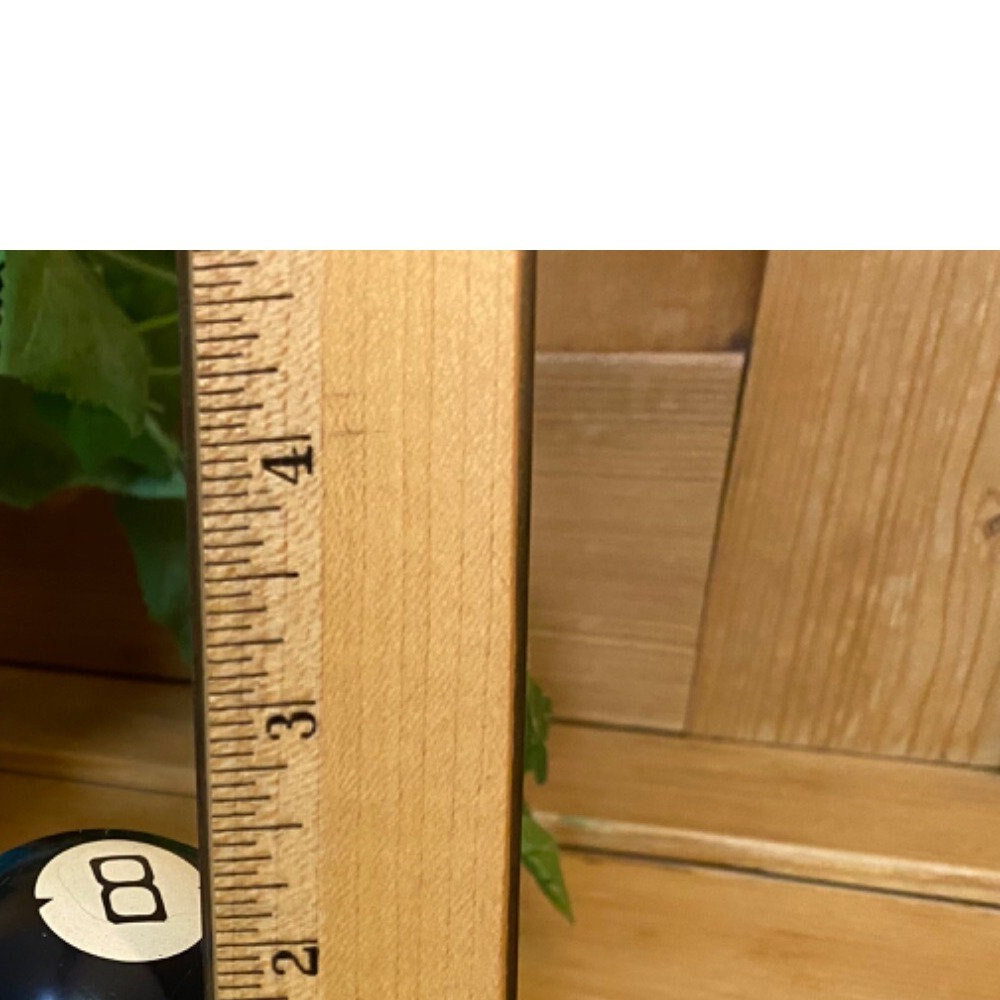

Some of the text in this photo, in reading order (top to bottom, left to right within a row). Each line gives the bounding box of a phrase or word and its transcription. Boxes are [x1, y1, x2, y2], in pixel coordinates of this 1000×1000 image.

[259, 444, 313, 485] 4
[265, 710, 318, 741] 3
[89, 855, 168, 925] 8
[271, 946, 320, 976] 2
